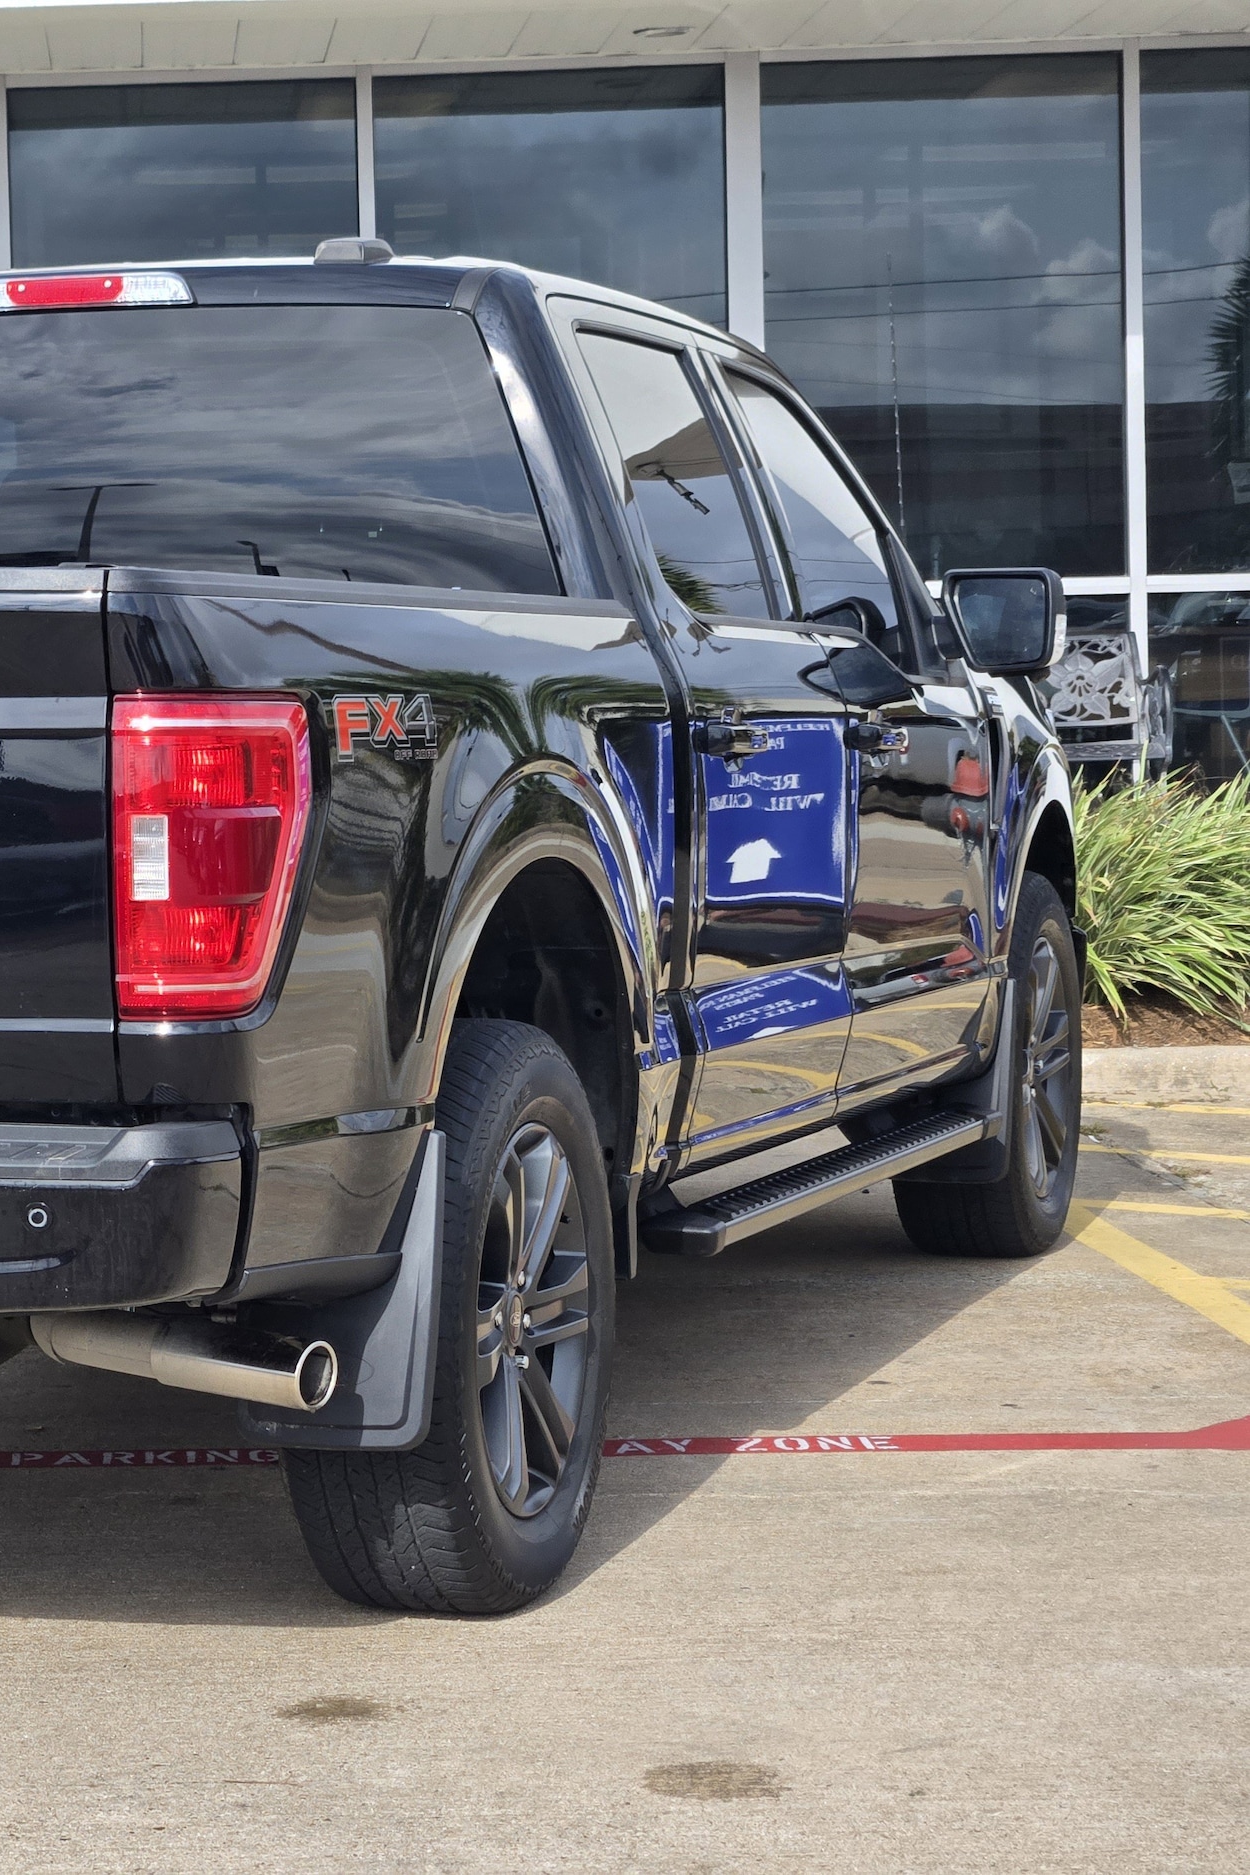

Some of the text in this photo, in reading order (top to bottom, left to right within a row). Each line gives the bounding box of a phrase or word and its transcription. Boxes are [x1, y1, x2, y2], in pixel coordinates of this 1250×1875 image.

[332, 694, 438, 762] FX4
[11, 1449, 280, 1466] PARKING
[616, 1438, 694, 1454] AY
[730, 1436, 900, 1452] ZONE
